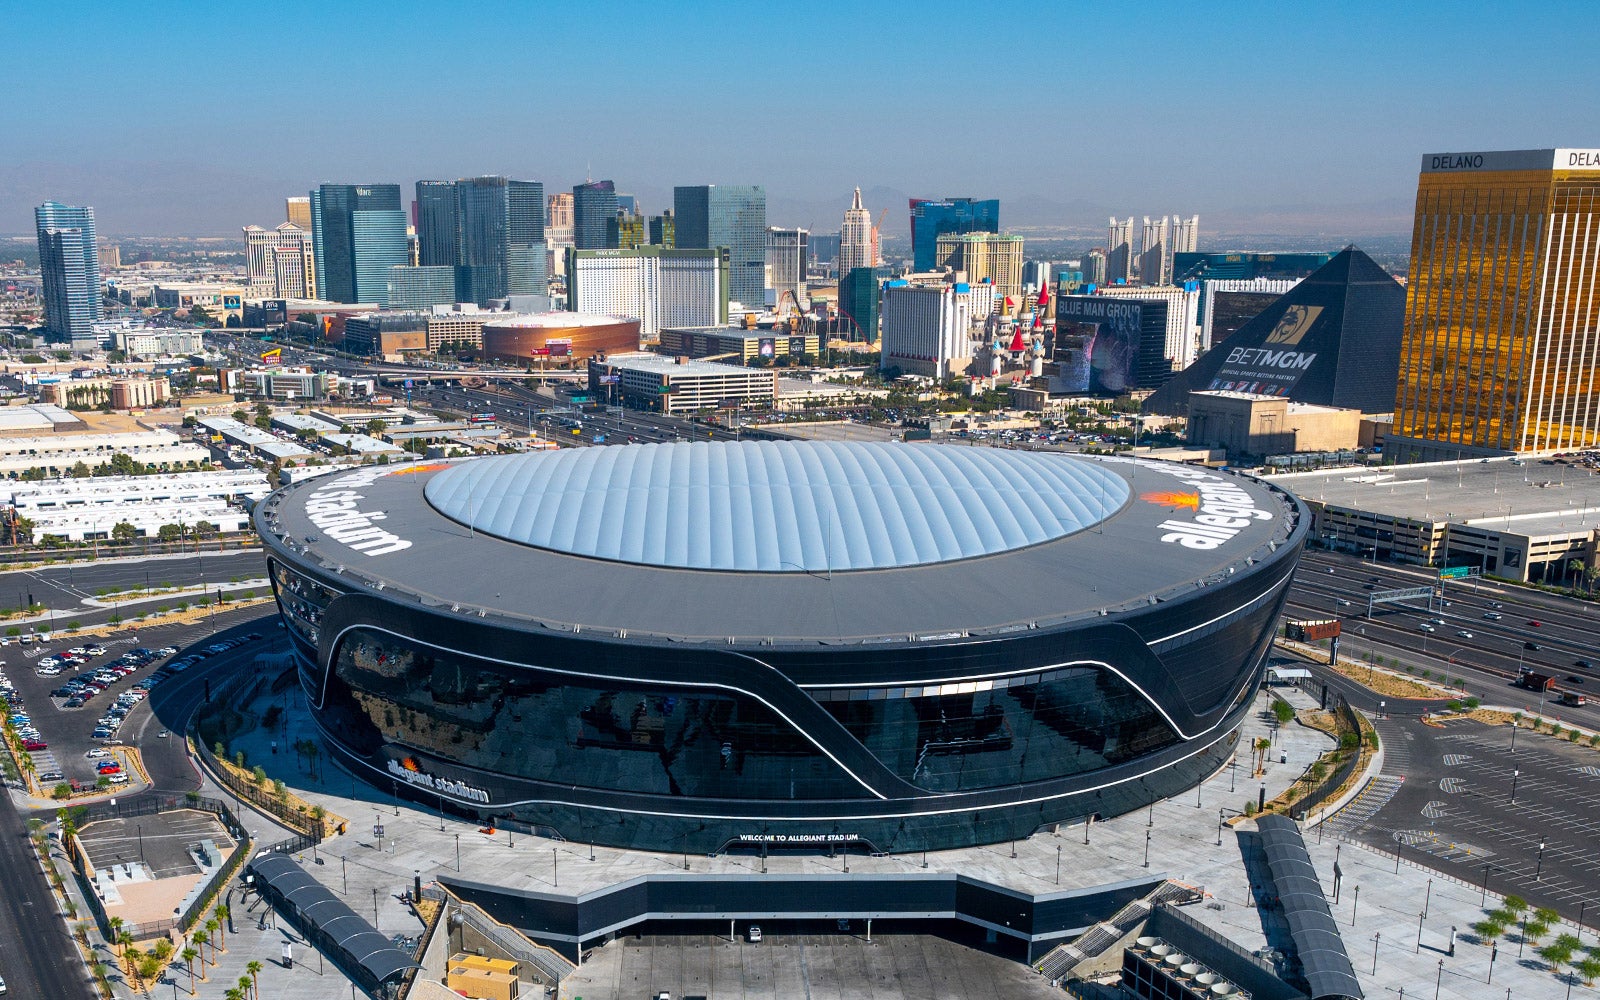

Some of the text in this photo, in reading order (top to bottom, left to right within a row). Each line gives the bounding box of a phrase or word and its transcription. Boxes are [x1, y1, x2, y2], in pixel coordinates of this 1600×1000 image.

[1431, 154, 1484, 170] DELANO
[1059, 301, 1141, 319] BLUE MAN GROUP
[1225, 347, 1318, 370] BETMGM
[1240, 370, 1257, 378] SPORTS
[387, 759, 489, 803] allegiant stadium
